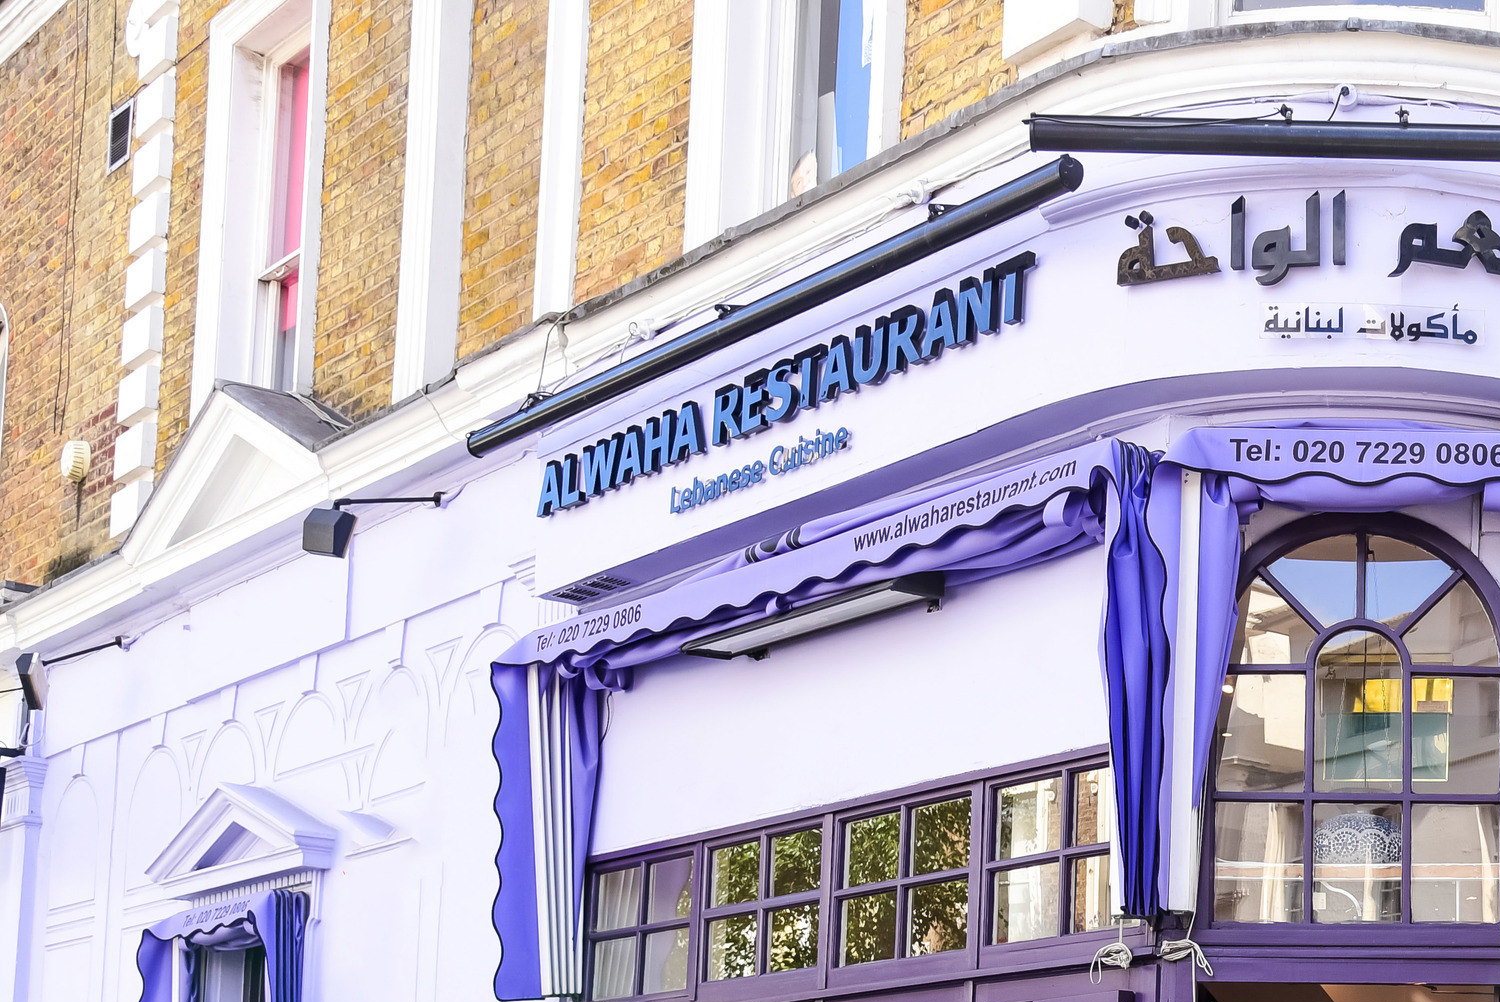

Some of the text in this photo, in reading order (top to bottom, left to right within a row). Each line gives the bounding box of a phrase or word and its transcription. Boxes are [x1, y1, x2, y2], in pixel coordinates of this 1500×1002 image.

[1116, 189, 1346, 287] الواحة
[1263, 304, 1479, 345] مأكولات لبنانية
[537, 251, 1038, 518] ALWAHA RESTAURANT
[669, 425, 849, 515] Lebanese Cuisine
[1229, 438, 1281, 462] Tel:
[1292, 440, 1345, 464] 020
[1356, 441, 1426, 465] 7229
[853, 458, 1077, 552] www.alwaharestaurant.com
[537, 604, 641, 653] Tel: 020 7229 0806
